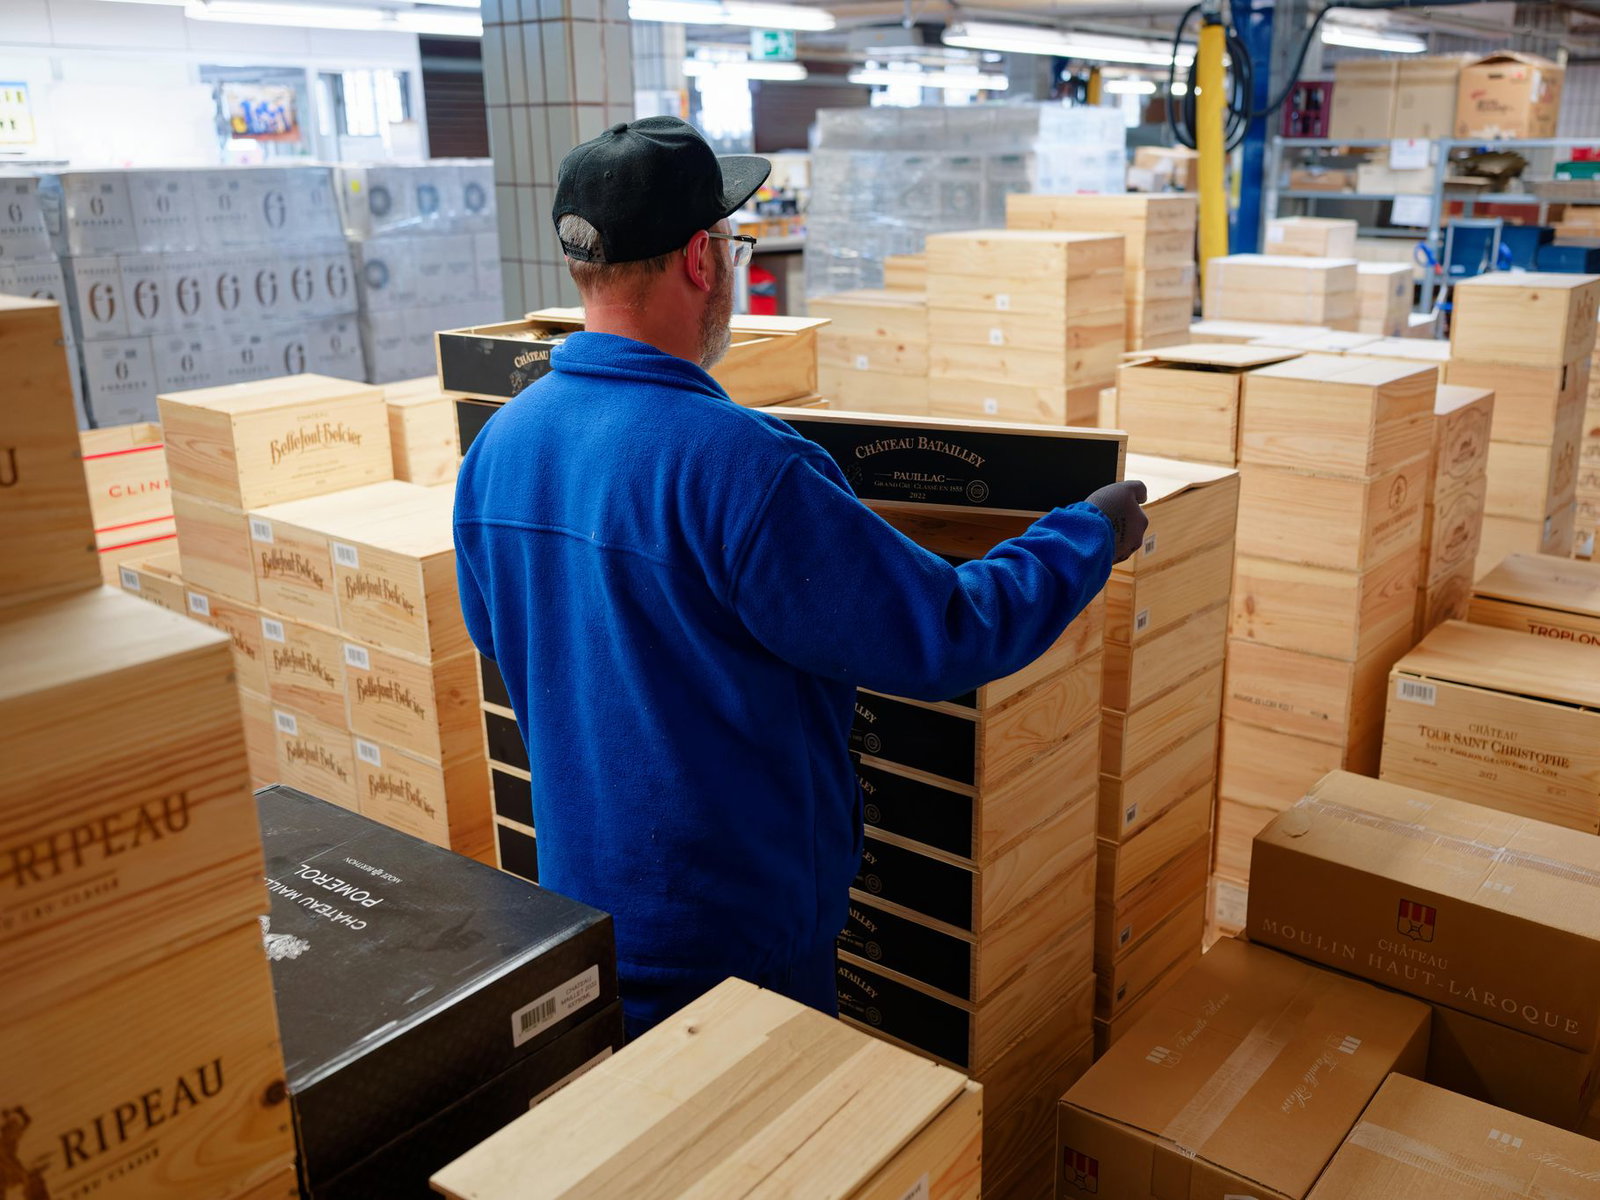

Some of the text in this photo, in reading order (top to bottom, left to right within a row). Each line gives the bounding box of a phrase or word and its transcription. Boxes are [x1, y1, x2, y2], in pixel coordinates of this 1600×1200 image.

[514, 350, 549, 368] CHÂTEAU
[855, 436, 986, 468] CHÂTEAU BATAILLEY
[874, 480, 898, 488] GRAND
[893, 471, 945, 482] PAUILLAC
[1418, 724, 1570, 769] TOUR SAINT CHRISTOPHE
[1469, 721, 1518, 741] CHÂTEAU
[10, 791, 190, 890] RIPEAU
[264, 877, 367, 930] CHÂTEAU MAILL
[294, 864, 384, 908] POMEROL
[1378, 938, 1448, 970] CHÂTEAU
[1263, 918, 1580, 1034] MOULIN HAUT-LAROQUE
[59, 1057, 223, 1170] RIPEAU
